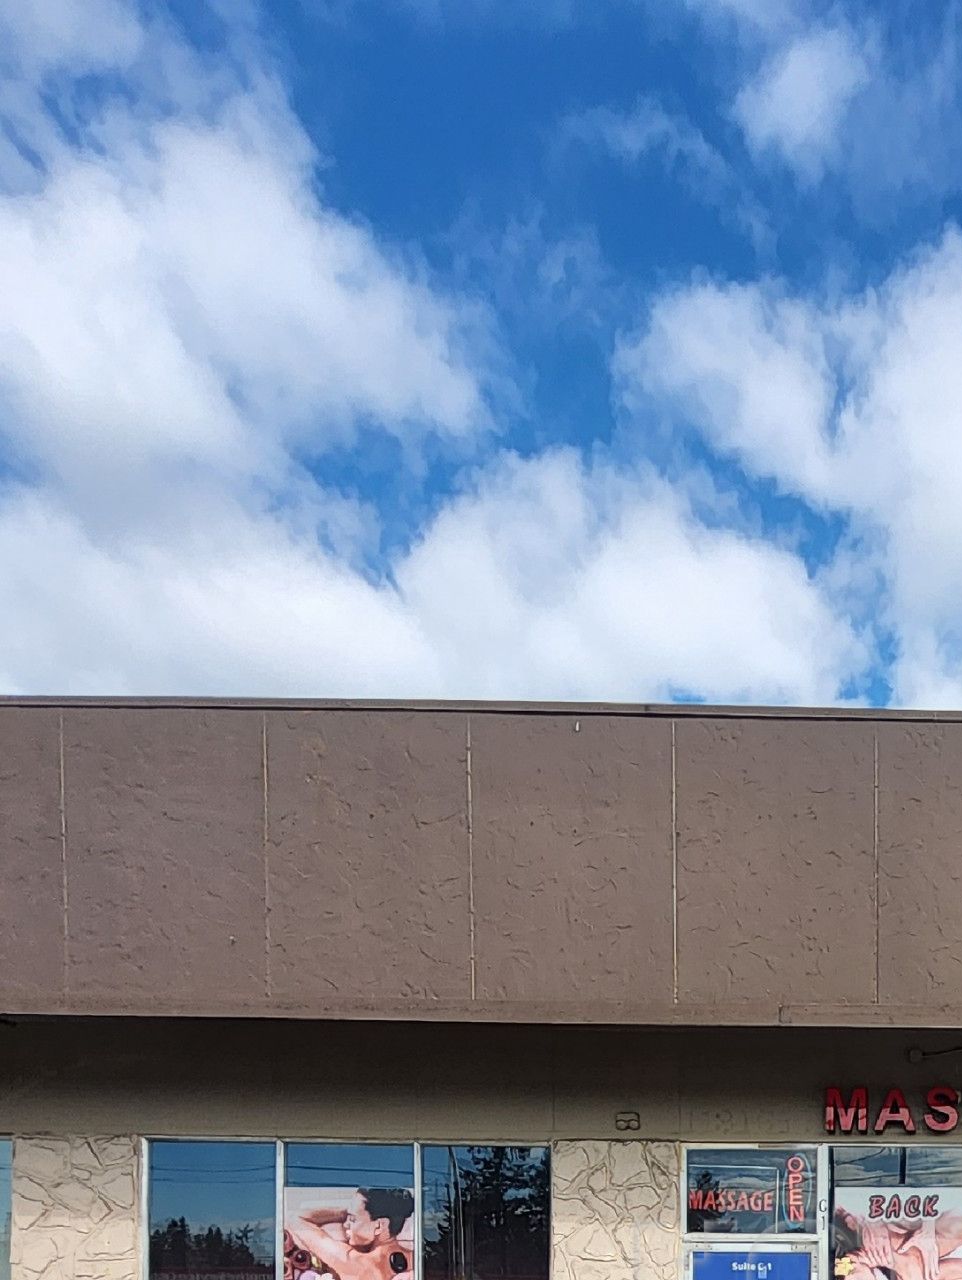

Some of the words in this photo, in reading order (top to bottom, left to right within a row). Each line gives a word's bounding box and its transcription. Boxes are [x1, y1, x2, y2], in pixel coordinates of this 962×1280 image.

[689, 1189, 775, 1212] MASSAGE
[787, 1156, 805, 1222] OPEN
[869, 1194, 939, 1219] BACK
[731, 1262, 756, 1271] Suite
